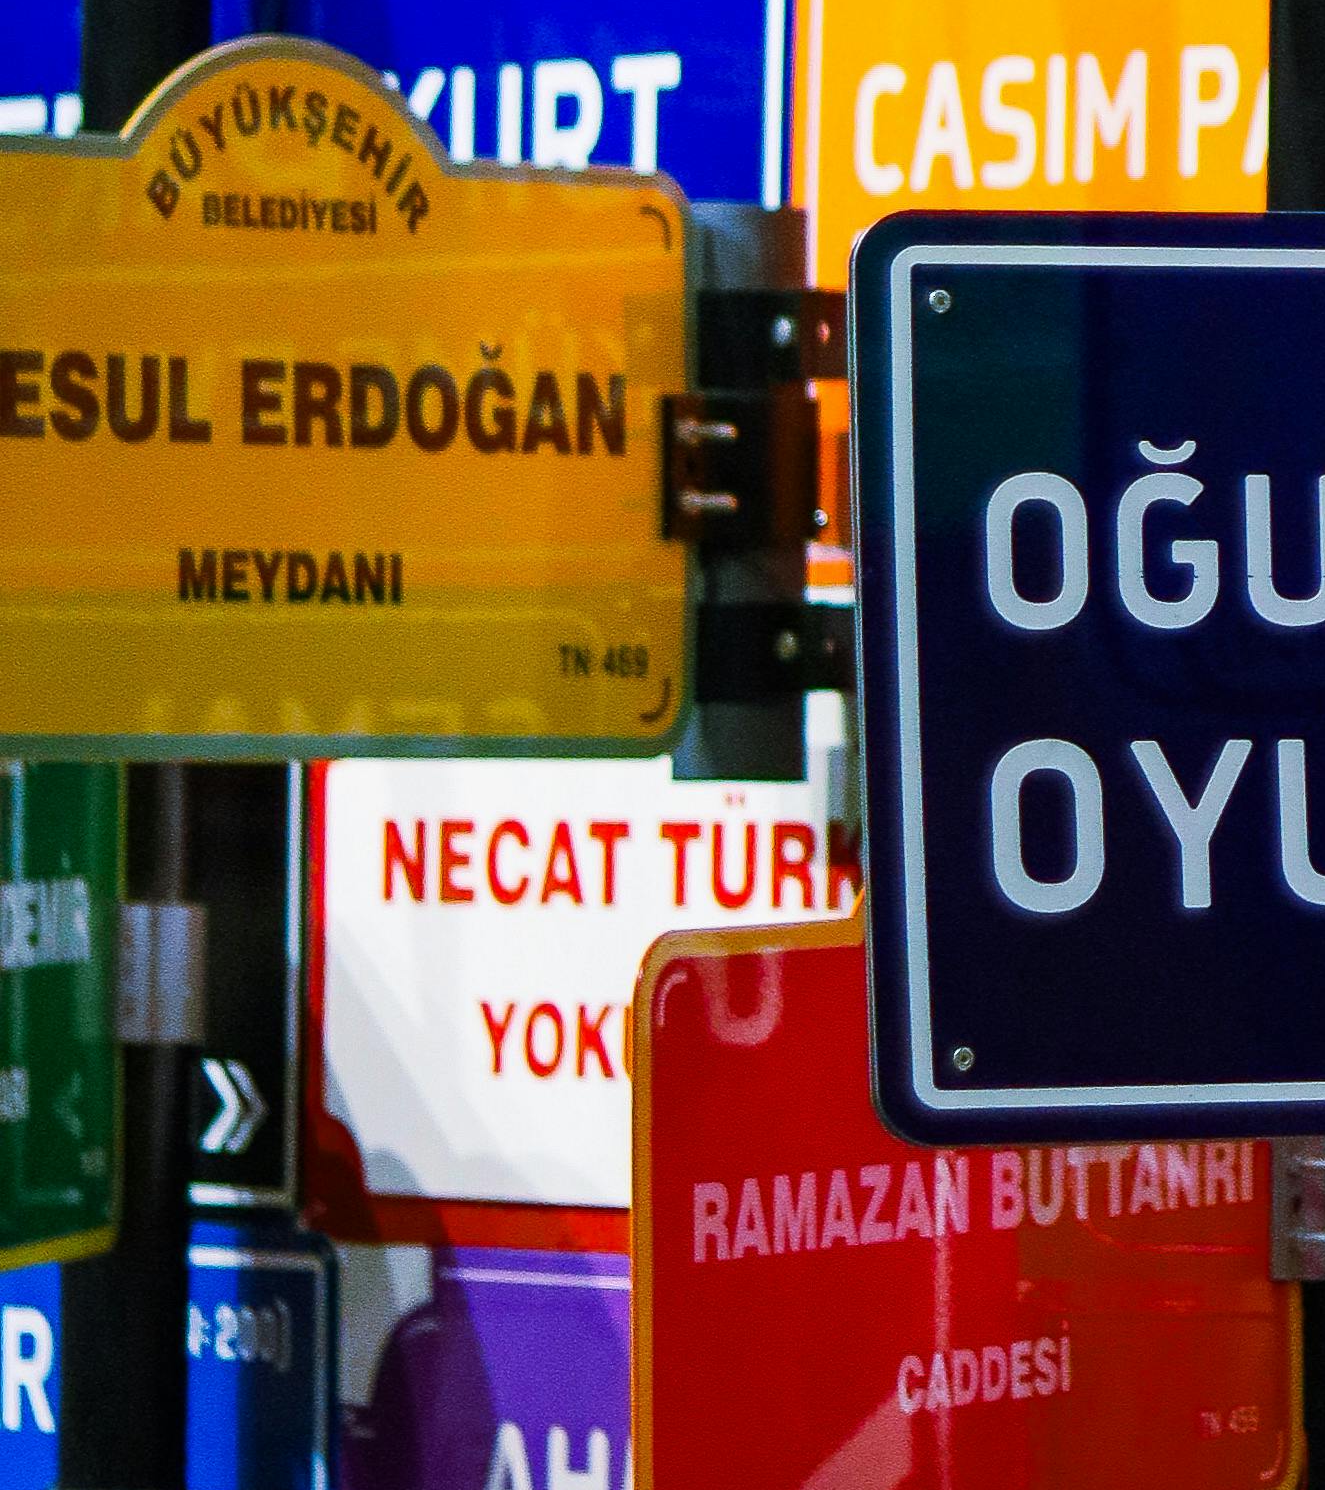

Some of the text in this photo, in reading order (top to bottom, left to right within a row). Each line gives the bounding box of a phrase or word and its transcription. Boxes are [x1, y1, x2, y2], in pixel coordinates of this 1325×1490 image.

[146, 84, 431, 236] BÜYÜKŞEHİR
[853, 48, 1149, 196] CASIM
[202, 189, 379, 236] BELEDİYESİ
[241, 344, 627, 460] ERDOĞAN
[178, 546, 405, 606] MEYDANI
[381, 815, 632, 908] NECAT
[691, 1138, 1256, 1264] RAMAZAN BUTTANRI
[896, 1319, 1074, 1416] CADDESİ
